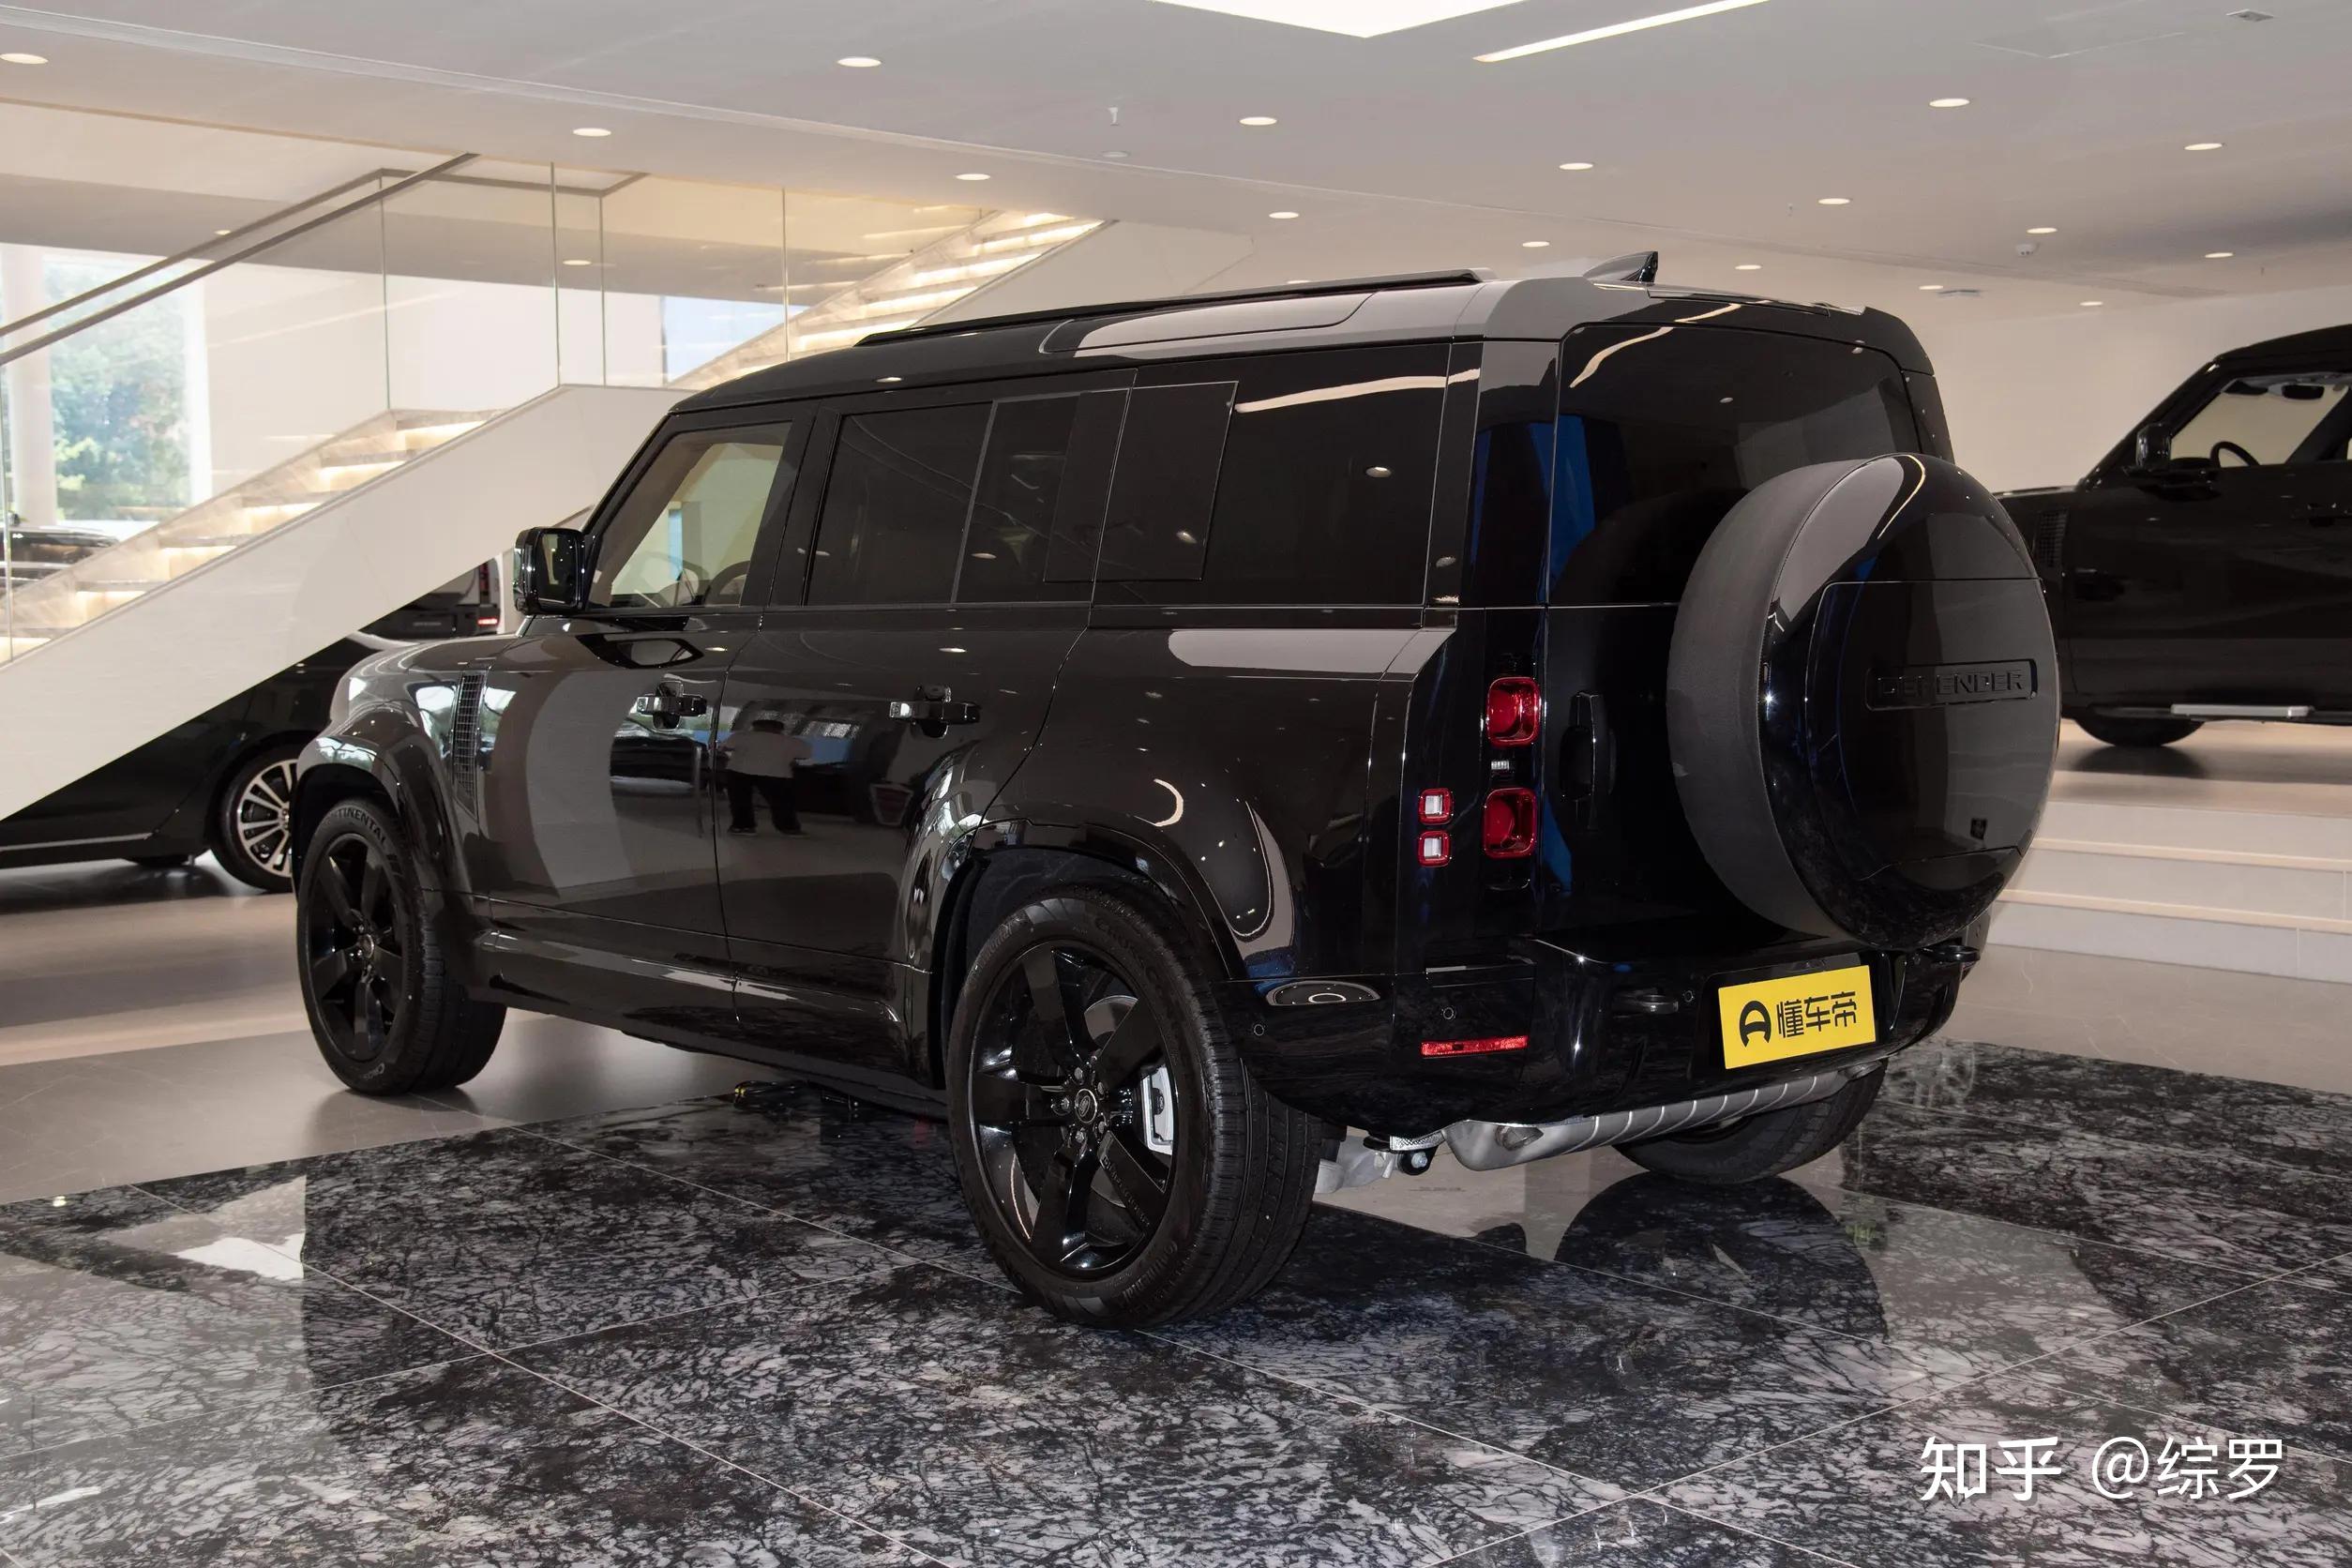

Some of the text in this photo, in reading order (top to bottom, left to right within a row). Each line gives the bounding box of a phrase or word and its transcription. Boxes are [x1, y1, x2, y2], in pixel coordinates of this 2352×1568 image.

[1877, 670, 2023, 698] DEFENDER
[1776, 991, 1858, 1038] 懂车帝
